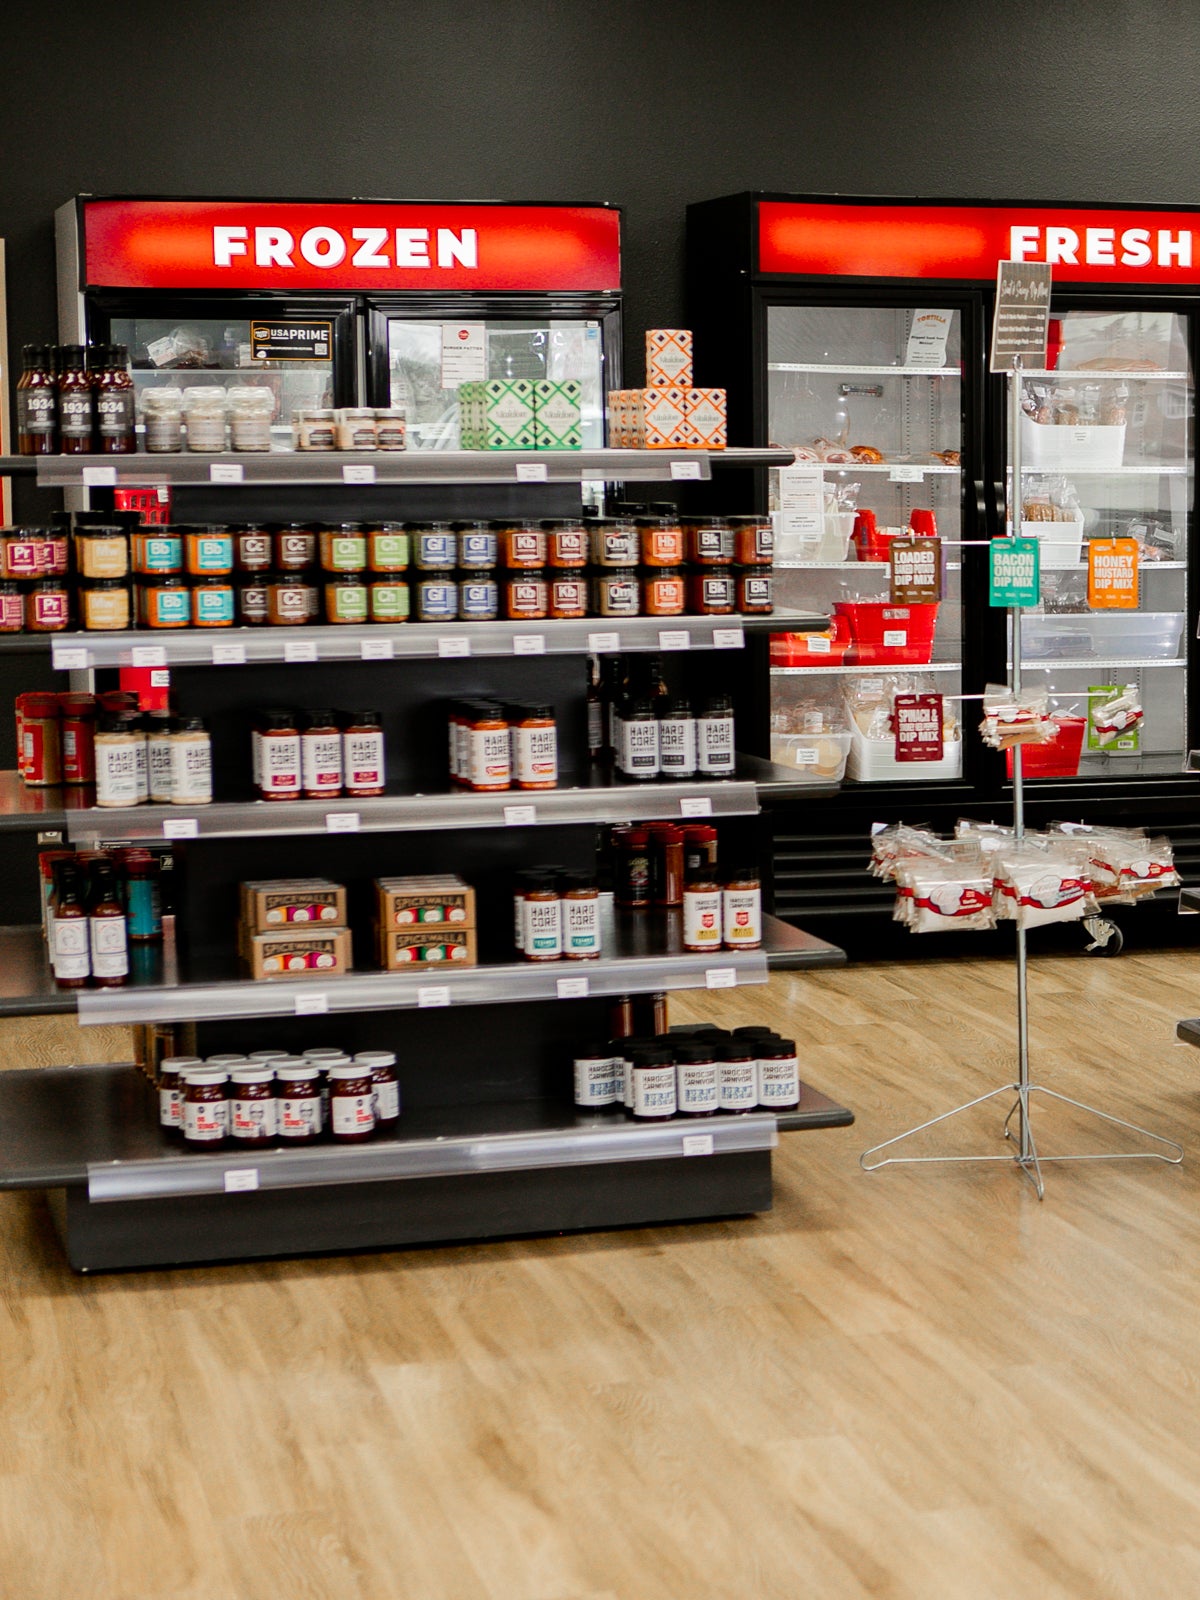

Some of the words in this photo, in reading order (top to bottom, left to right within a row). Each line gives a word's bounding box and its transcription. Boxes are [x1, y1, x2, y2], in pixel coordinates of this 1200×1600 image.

[212, 226, 478, 268] FROZEN
[1010, 225, 1192, 268] FRESH
[270, 328, 289, 337] USA
[290, 329, 329, 341] PRIME
[27, 398, 56, 410] 1934
[62, 402, 92, 414] 1934
[97, 402, 125, 413] 1934
[286, 538, 306, 551] Cc
[426, 538, 444, 550] Gf
[468, 538, 486, 550] Gf
[517, 536, 536, 549] Kb
[561, 535, 580, 548] Kb
[657, 534, 676, 548] Hb
[702, 532, 720, 546] Bk
[150, 542, 170, 555] Bb
[204, 542, 223, 555] Bb
[246, 540, 264, 552] Cc
[14, 546, 30, 559] Pr
[893, 550, 935, 564] LOADED
[992, 553, 1034, 566] BACON
[1094, 556, 1134, 568] HONEY
[993, 566, 1034, 577] ONION
[1094, 567, 1134, 579] MUSTARD
[894, 574, 913, 586] DIP
[913, 574, 935, 586] MIX
[993, 576, 1012, 588] DIP
[1012, 576, 1034, 588] MIX
[1094, 578, 1112, 589] DIP
[1112, 578, 1134, 590] MIX
[516, 586, 536, 599] Kb
[558, 585, 578, 598] Kb
[659, 584, 677, 596] Hb
[708, 582, 726, 594] Bk
[750, 580, 768, 593] Bk
[246, 592, 264, 604] Cc
[283, 592, 302, 605] Cc
[428, 588, 444, 600] Gf
[468, 588, 486, 600] Gf
[42, 598, 60, 611] Pr
[162, 595, 182, 608] Bb
[204, 594, 223, 607] Bb
[630, 726, 656, 736] HARD
[660, 725, 684, 736] HARD
[706, 724, 730, 734] HARD
[630, 736, 656, 746] CORE
[660, 735, 685, 746] CORE
[706, 734, 730, 744] CORE
[899, 731, 918, 742] DIP
[918, 730, 940, 742] MIX
[266, 893, 336, 909] SPICEWALLA
[396, 896, 464, 912] SPICEWALLA
[398, 933, 464, 949] SPICEWALLA
[264, 942, 334, 958] SPICEWALLA
